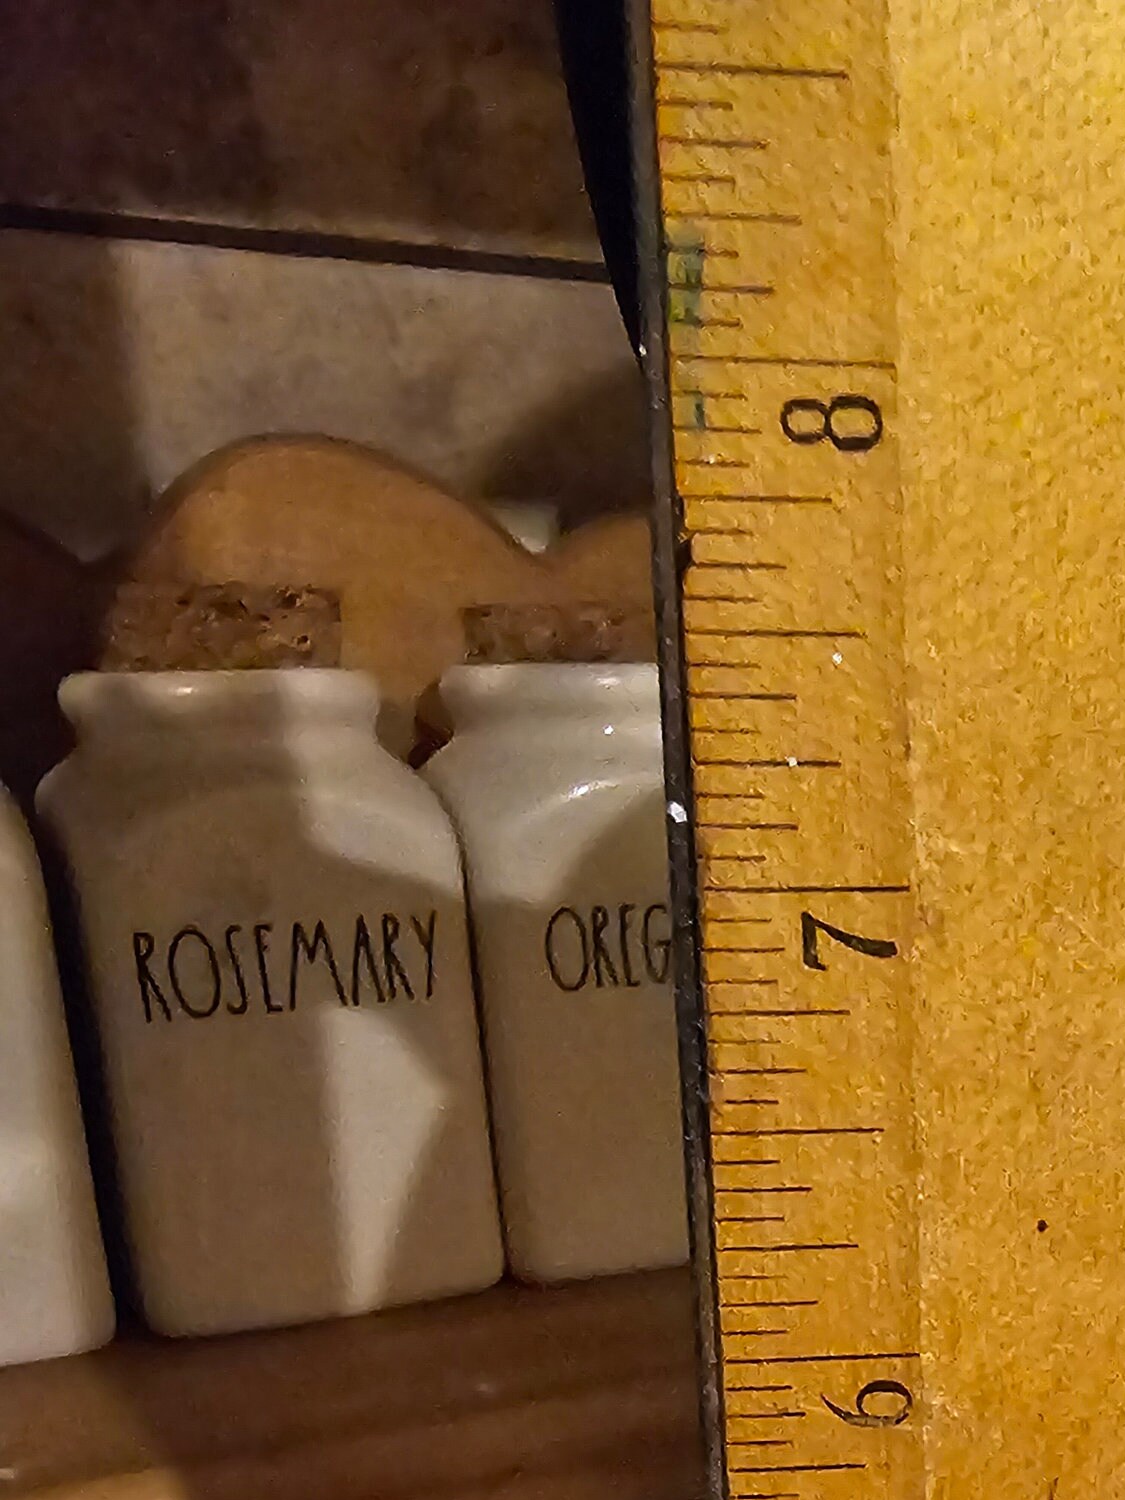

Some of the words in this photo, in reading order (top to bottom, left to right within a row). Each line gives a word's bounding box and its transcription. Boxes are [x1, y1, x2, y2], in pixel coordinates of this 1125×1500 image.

[780, 392, 883, 452] 8
[133, 909, 437, 1024] ROSEMARY
[545, 903, 672, 992] OREG
[801, 911, 899, 971] 7
[820, 1379, 913, 1426] 6
